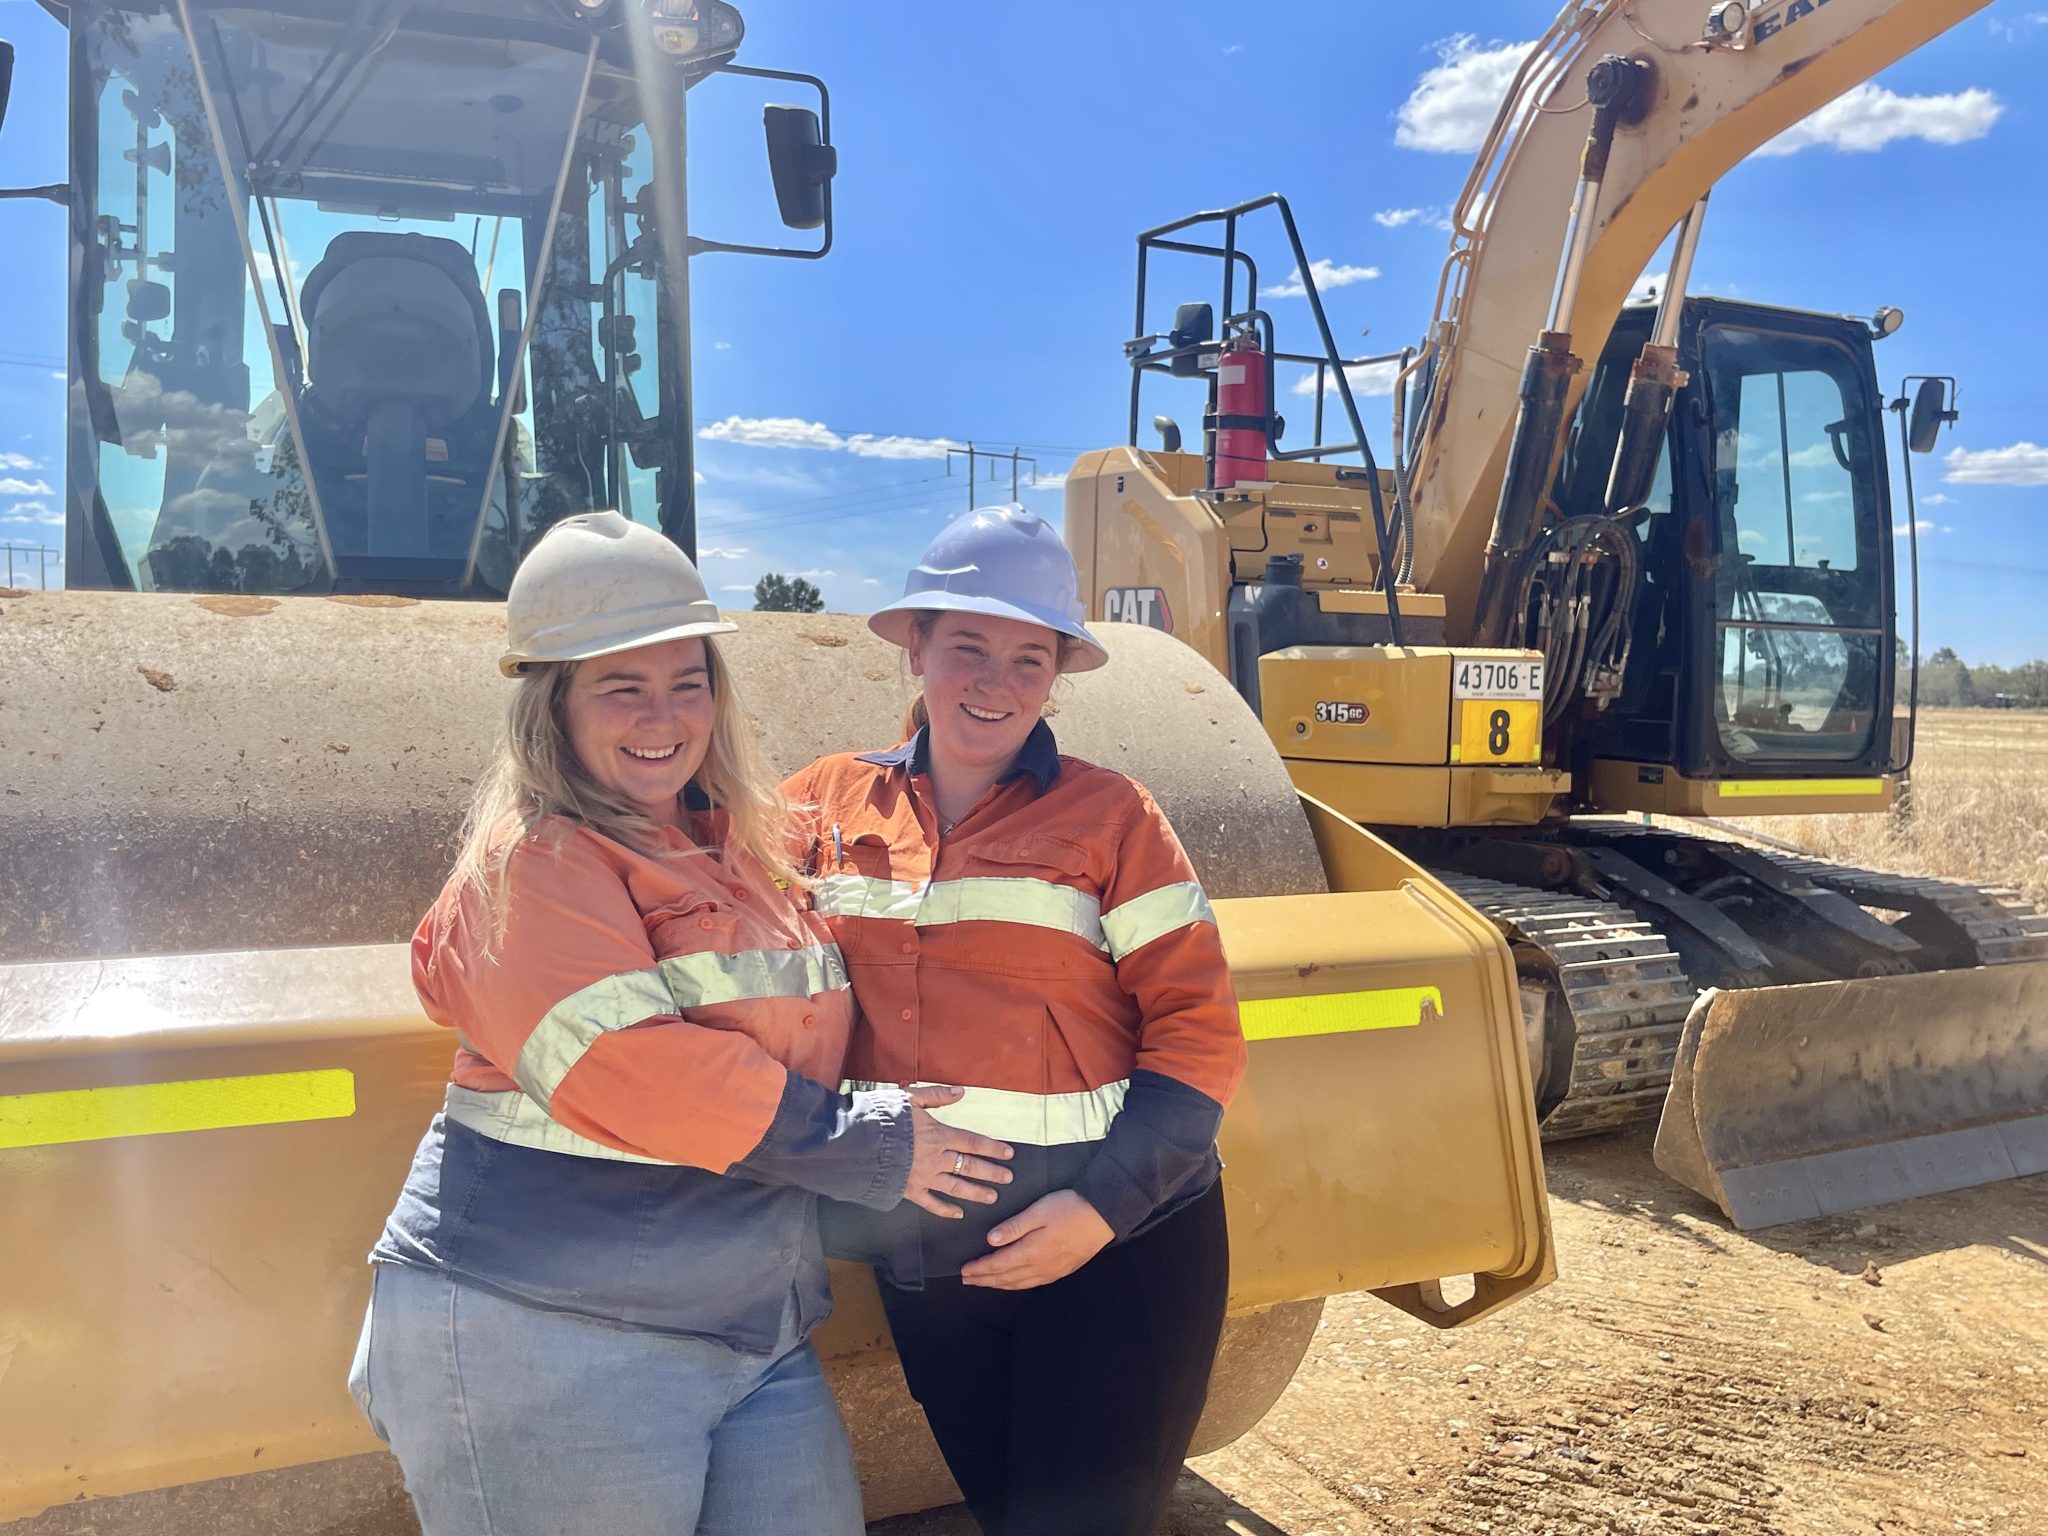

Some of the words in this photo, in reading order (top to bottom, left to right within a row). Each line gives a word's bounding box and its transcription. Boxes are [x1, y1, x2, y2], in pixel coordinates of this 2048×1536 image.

[1753, 0, 1831, 45] EA
[1104, 589, 1155, 626] CAT
[1316, 702, 1349, 722] 315
[1489, 709, 1510, 756] 8
